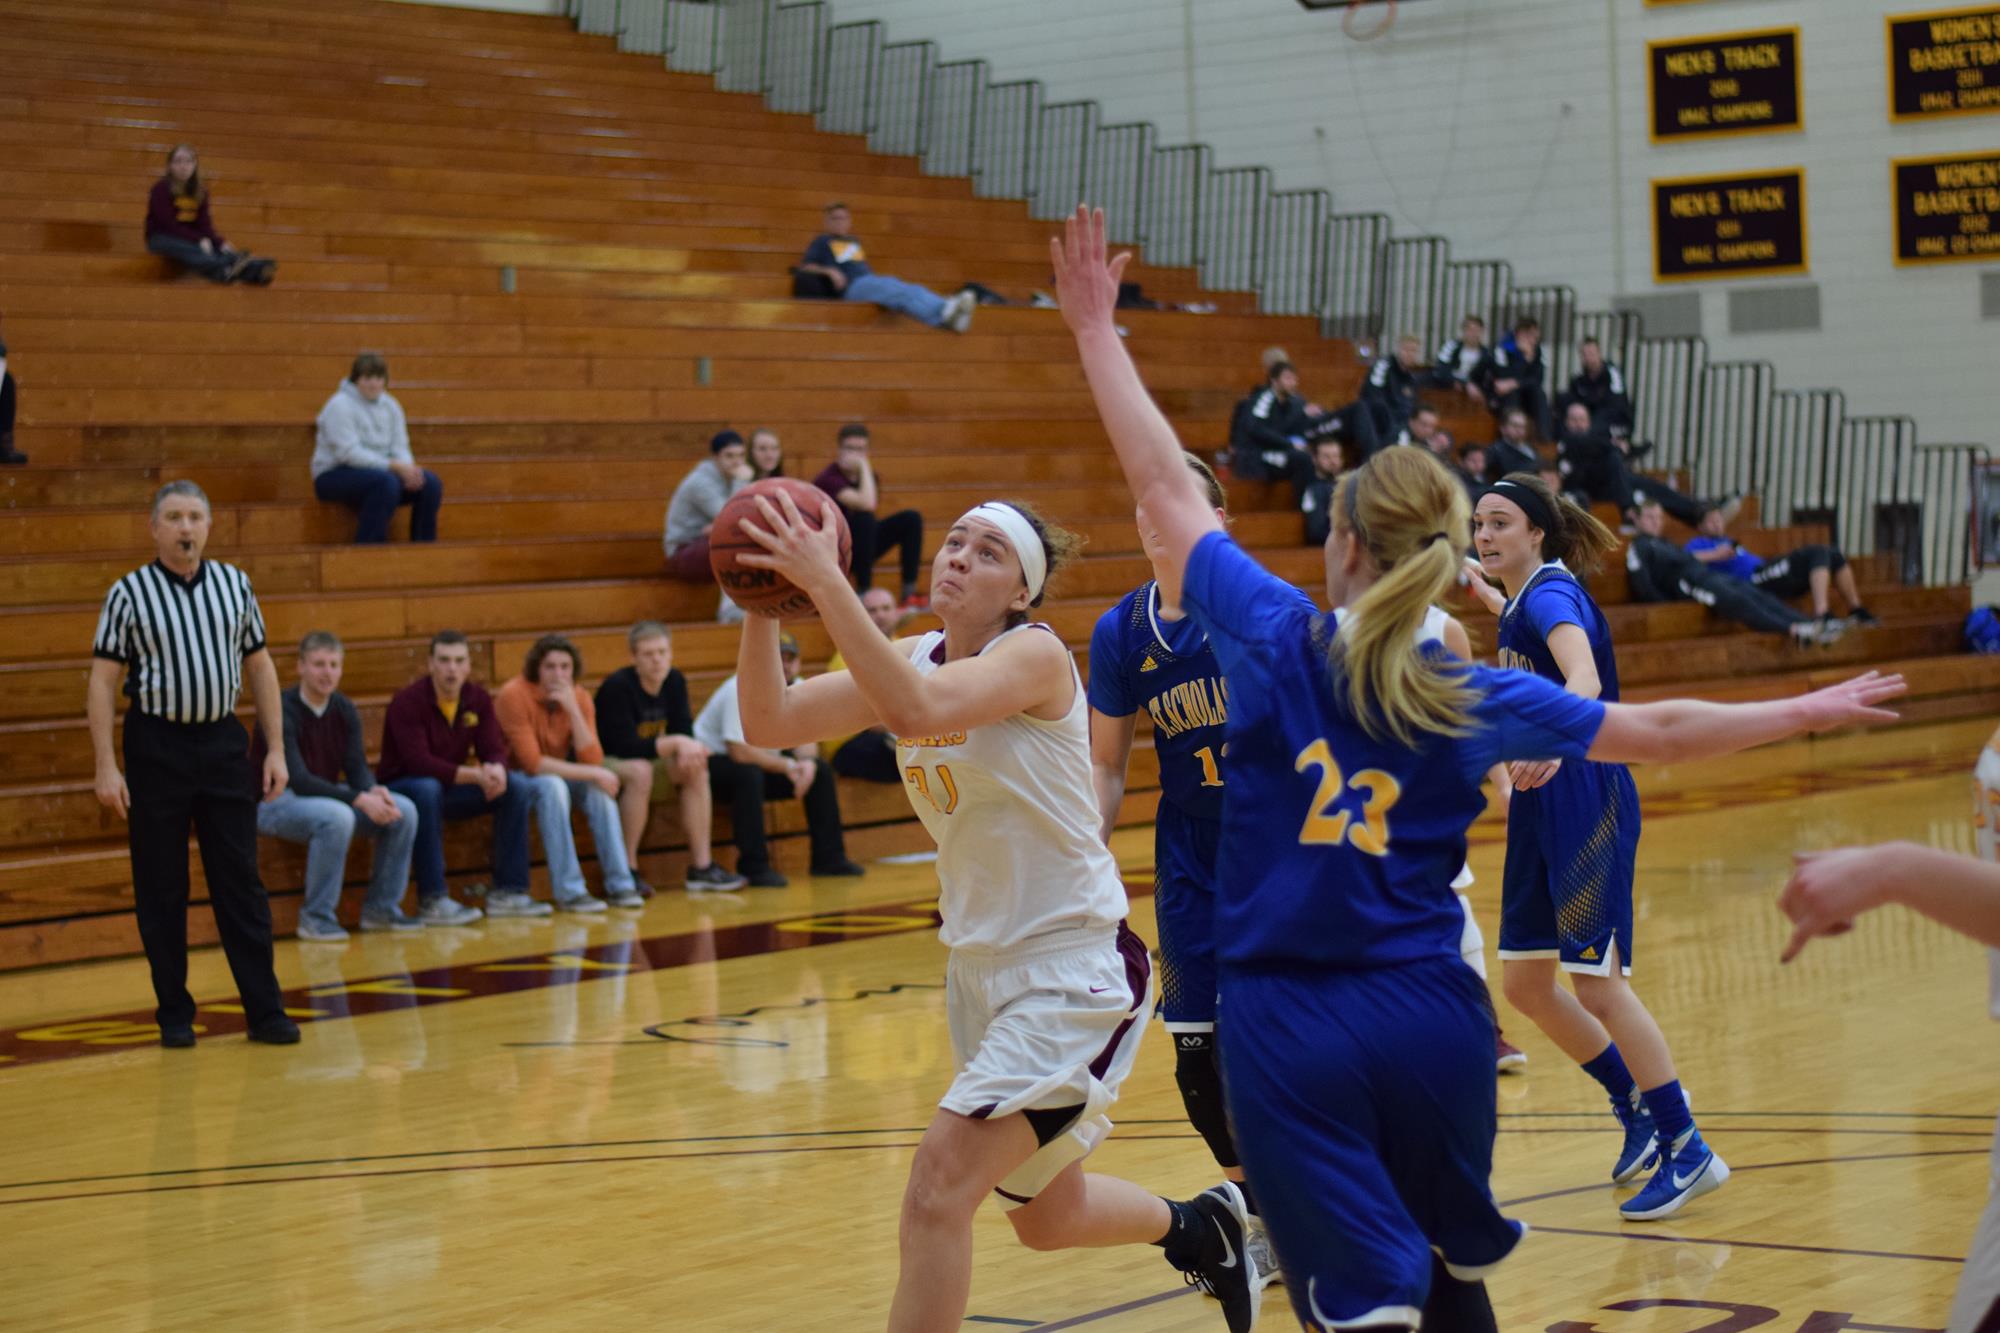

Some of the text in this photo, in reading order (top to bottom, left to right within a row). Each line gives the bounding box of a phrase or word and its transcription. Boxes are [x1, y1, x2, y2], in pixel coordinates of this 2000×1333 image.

[1665, 43, 1781, 77] MEN'S TRACK
[1670, 185, 1785, 218] MEN'S TRACK
[1294, 738, 1400, 856] 23
